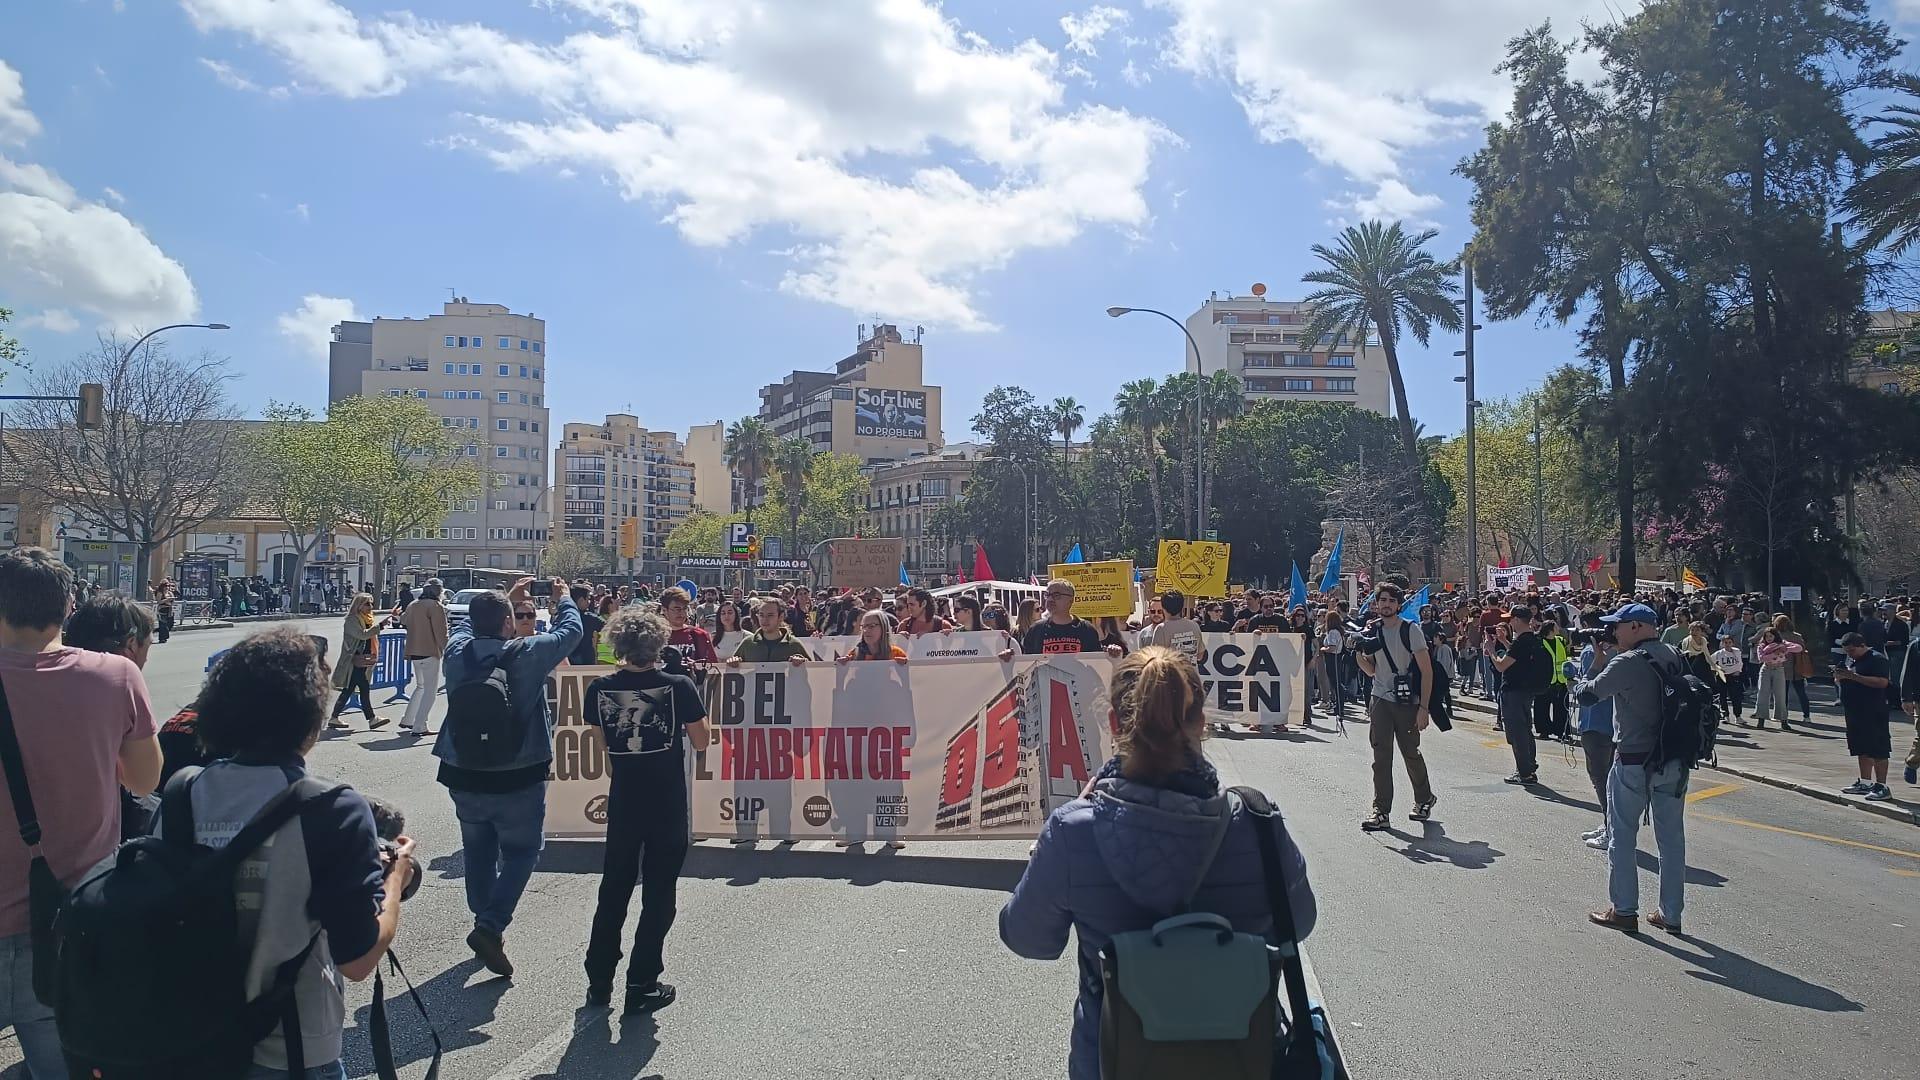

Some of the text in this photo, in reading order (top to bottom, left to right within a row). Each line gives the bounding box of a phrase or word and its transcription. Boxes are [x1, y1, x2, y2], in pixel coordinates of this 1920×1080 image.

[858, 426, 922, 437] NO PROBLEM
[733, 524, 748, 542] P
[182, 587, 209, 597] TACOS
[1045, 644, 1060, 652] NO
[754, 672, 792, 725] EL
[720, 797, 765, 821] SHP
[878, 806, 907, 814] NO ES
